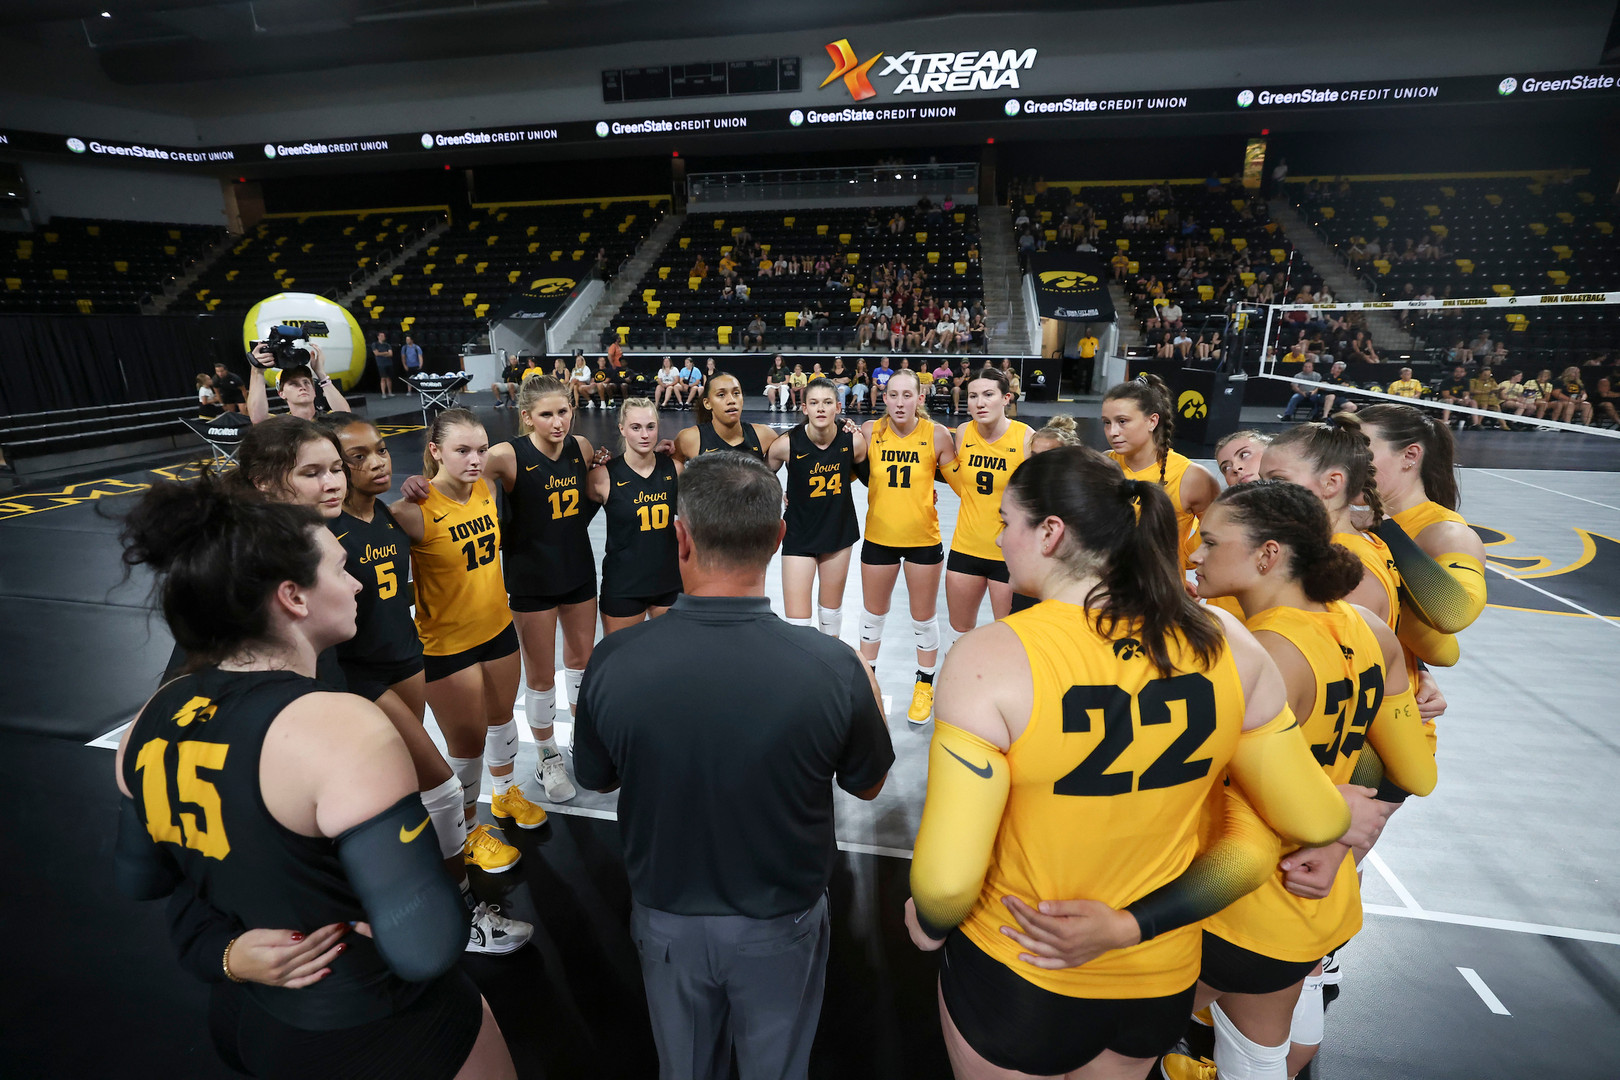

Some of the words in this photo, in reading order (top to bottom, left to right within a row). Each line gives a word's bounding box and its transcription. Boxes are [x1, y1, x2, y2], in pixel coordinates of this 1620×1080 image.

[879, 48, 1038, 76] XTREAM
[893, 69, 1020, 95] ARENA
[1522, 74, 1614, 93] GreenState
[1024, 98, 1098, 114] GreenState
[1100, 98, 1144, 111] CREDIT
[1147, 97, 1187, 109] UNION
[1258, 88, 1339, 105] GreenState
[1340, 88, 1391, 101] CREDIT
[1393, 86, 1439, 99] UNION
[807, 108, 874, 124] GreenState
[876, 108, 917, 120] CREDIT
[919, 107, 957, 118] UNION
[612, 119, 673, 135] GreenState
[674, 119, 711, 131] CREDIT
[713, 117, 747, 128] UNION
[435, 132, 491, 146] GreenState
[491, 131, 525, 142] CREDIT
[527, 129, 558, 140] UNION
[89, 141, 169, 160] GreenState
[170, 152, 207, 162] CREDIT
[209, 151, 235, 161] UNION
[277, 142, 328, 157] GreenState
[328, 142, 359, 153] CREDIT
[360, 140, 389, 151] UNION
[1540, 295, 1559, 303] IOWA
[1560, 293, 1606, 302] VOLLEYBALL
[207, 427, 239, 436] molten
[881, 449, 920, 464] IOWA
[968, 454, 1007, 471] IOWA
[809, 462, 841, 475] Iowa
[886, 464, 911, 489] 11
[544, 474, 577, 490] Iowa
[808, 472, 842, 498] 24
[976, 470, 994, 496] 9
[547, 488, 579, 520] 12
[633, 490, 667, 504] Iowa
[636, 503, 670, 531] 10
[448, 513, 496, 543] IOWA
[359, 543, 398, 564] Iowa
[461, 532, 496, 572] 13
[374, 560, 398, 601] 5
[1053, 672, 1216, 797] 22
[135, 737, 231, 862] 15
